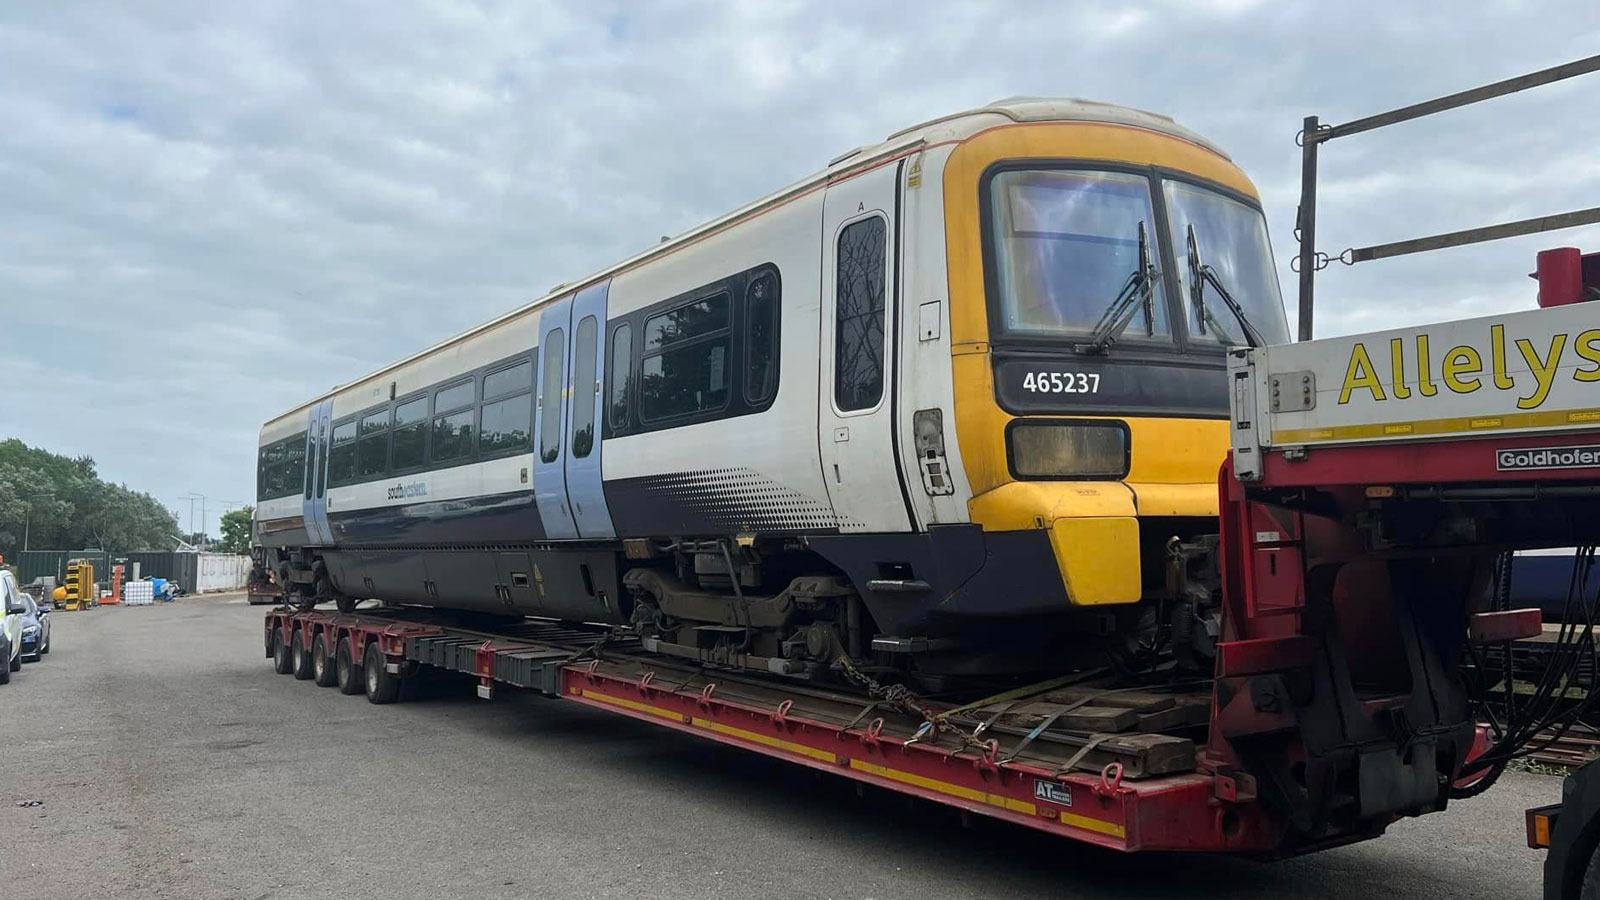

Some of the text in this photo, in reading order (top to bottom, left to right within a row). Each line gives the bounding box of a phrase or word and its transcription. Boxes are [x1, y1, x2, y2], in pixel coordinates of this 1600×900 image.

[1338, 324, 1600, 410] Allelys
[1023, 372, 1101, 394] 465237
[1500, 449, 1600, 467] Goldhofer
[1036, 781, 1053, 798] AT
